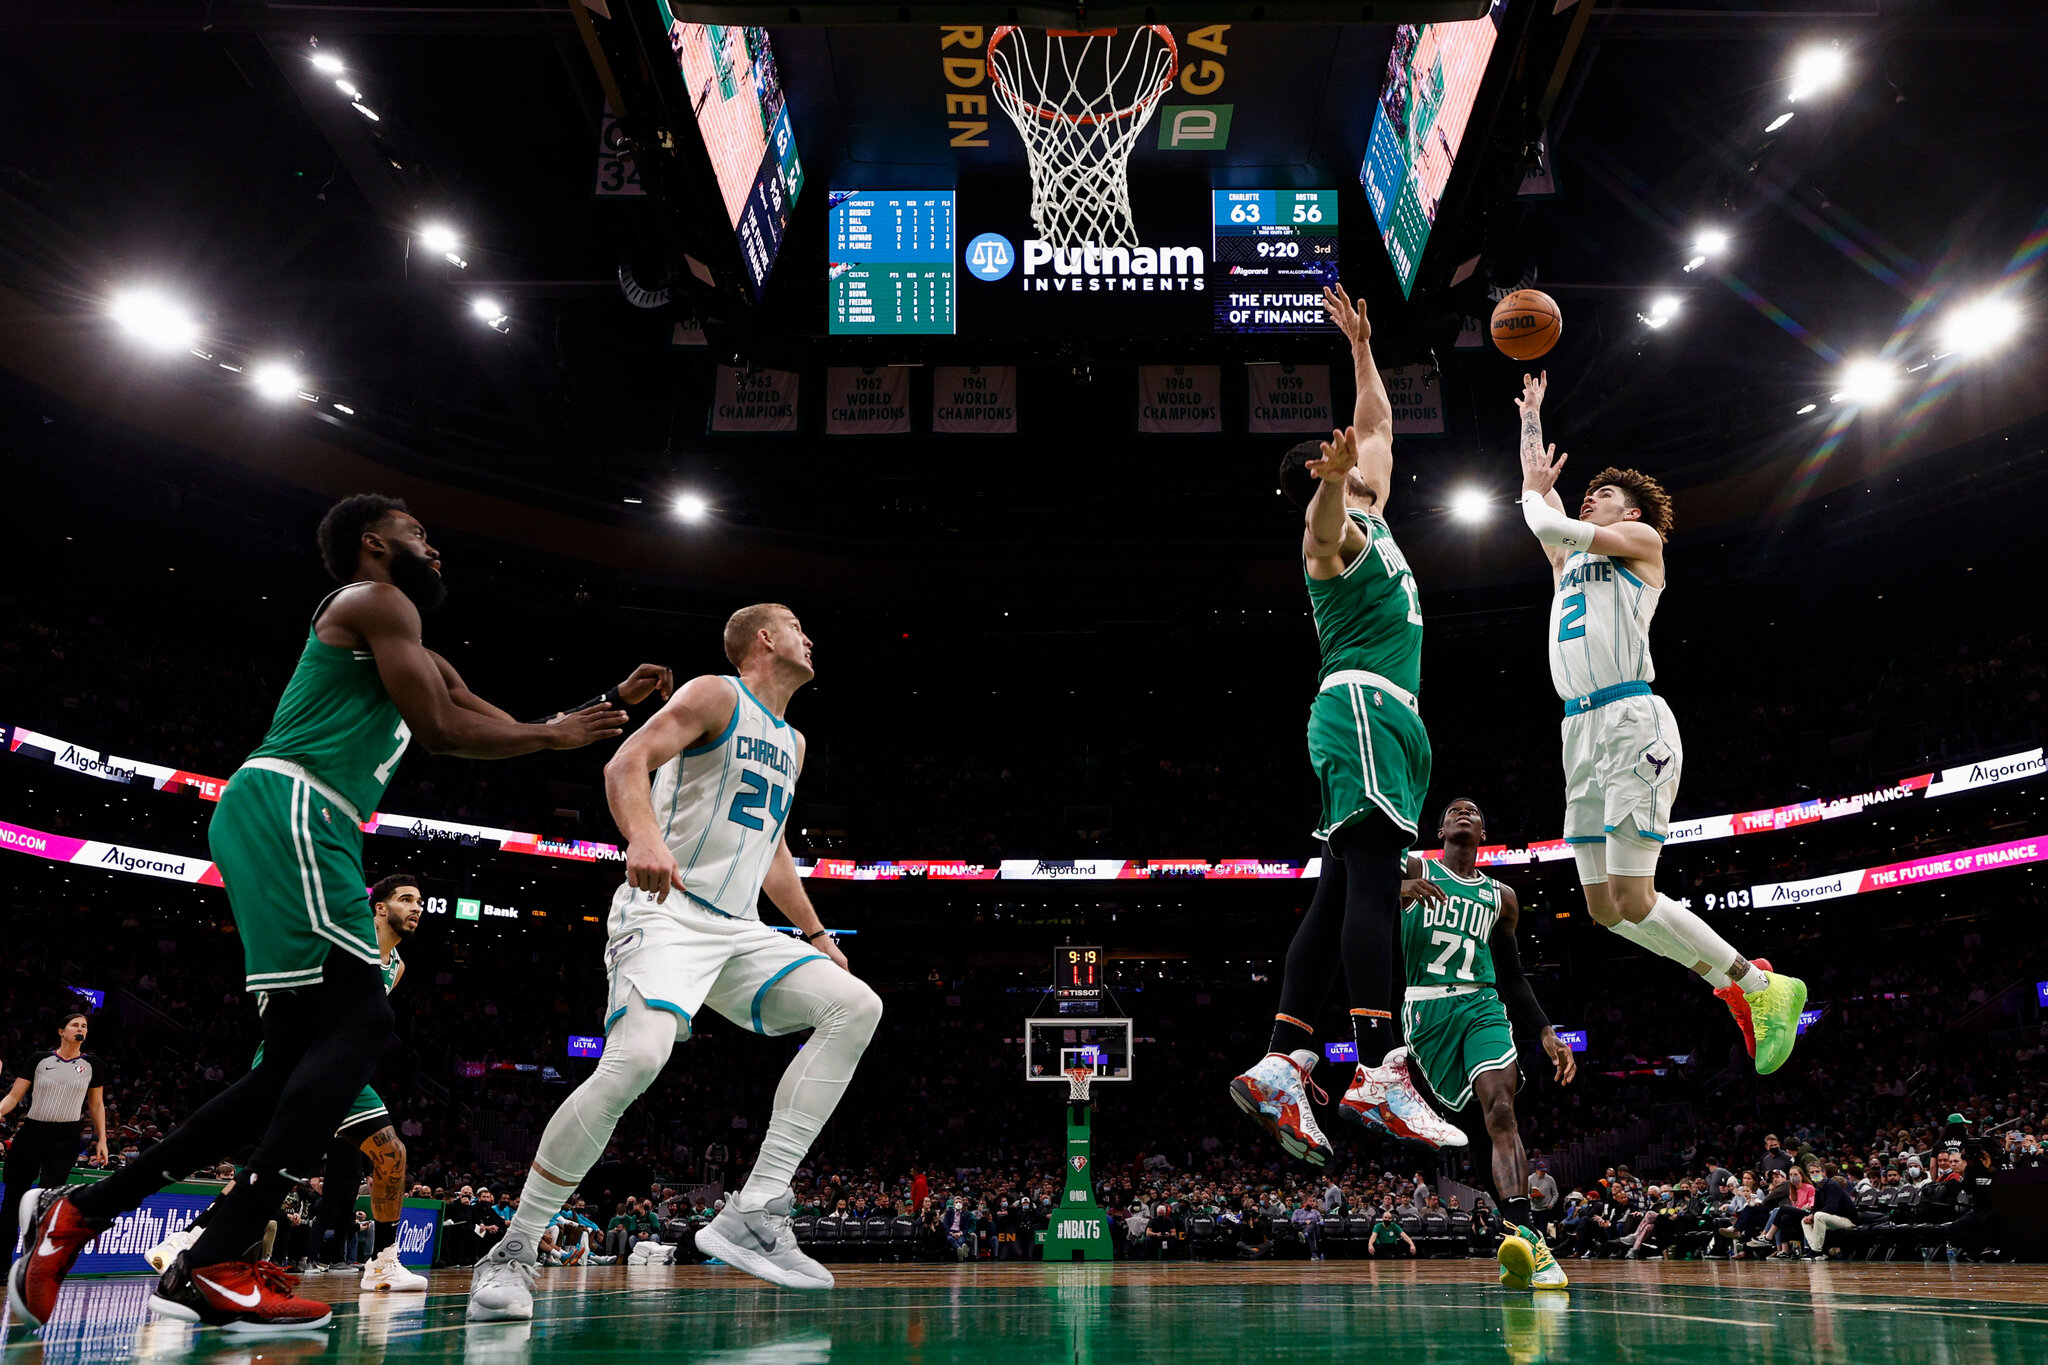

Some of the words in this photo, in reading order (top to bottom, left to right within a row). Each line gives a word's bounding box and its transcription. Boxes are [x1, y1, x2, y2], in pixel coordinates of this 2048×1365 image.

[1230, 204, 1260, 223] 63
[1293, 204, 1322, 223] 56
[849, 242, 872, 250] PLUMLEE
[1257, 242, 1299, 258] 9:20
[1314, 245, 1331, 254] 3rd
[1024, 240, 1204, 276] Putnam
[1230, 266, 1268, 276] Algorand
[1024, 278, 1205, 292] INVESTMENTS
[1229, 294, 1260, 306] THE
[1263, 294, 1324, 306] FUTURE
[1230, 310, 1250, 323] OF
[1254, 310, 1324, 323] FINANCE
[1494, 315, 1536, 330] Wilson
[856, 378, 881, 390] 1962
[962, 377, 986, 389] 1961
[1166, 378, 1193, 390] 1960
[1276, 377, 1303, 390] 1959
[1388, 378, 1412, 390] 1957
[736, 391, 779, 403] WORLD
[847, 392, 891, 406] WORLD
[953, 392, 997, 405] WORLD
[1157, 392, 1201, 405] WORLD
[1269, 392, 1312, 405] WORLD
[1390, 393, 1422, 405] ORLD
[719, 405, 792, 418] CHAMPIONS
[831, 407, 904, 421] CHAMPIONS
[938, 407, 1012, 420] CHAMPIONS
[1144, 407, 1216, 420] CHAMPIONS
[1254, 407, 1328, 420] CHAMPIONS
[1392, 408, 1438, 420] MPIONS
[1558, 592, 1586, 642] 2
[373, 719, 412, 786] 7
[60, 745, 136, 778] Algorand
[186, 778, 216, 796] THE
[1665, 824, 1702, 840] rand
[1742, 816, 1773, 830] THE
[1775, 803, 1827, 824] FUTURE
[1830, 798, 1848, 811] OF
[1850, 784, 1913, 808] FINANCE
[1969, 758, 2046, 783] Algorand
[728, 768, 794, 844] 24
[537, 840, 628, 862] WWW.ALGORAN
[101, 846, 186, 875] Algorand
[829, 864, 854, 876] THE
[929, 864, 984, 876] FINANCE
[1032, 860, 1096, 878] Algorand
[1234, 864, 1290, 875] FINANCE
[1704, 890, 1750, 910] 9:03
[1771, 880, 1842, 902] Algorand
[1870, 871, 1898, 885] THE
[1899, 860, 1952, 880] FUTURE
[1954, 856, 1972, 870] OF
[1975, 844, 2038, 866] FINANCE
[459, 902, 478, 916] TD
[484, 904, 518, 918] Bank
[1424, 895, 1494, 944] BOSTON
[1069, 951, 1096, 964] 9:19
[1427, 930, 1475, 980] 71
[573, 1041, 597, 1050] ULTRA
[1070, 1190, 1087, 1202] @NBA
[1057, 1220, 1100, 1239] #NBA75
[396, 1219, 433, 1254] Cares
